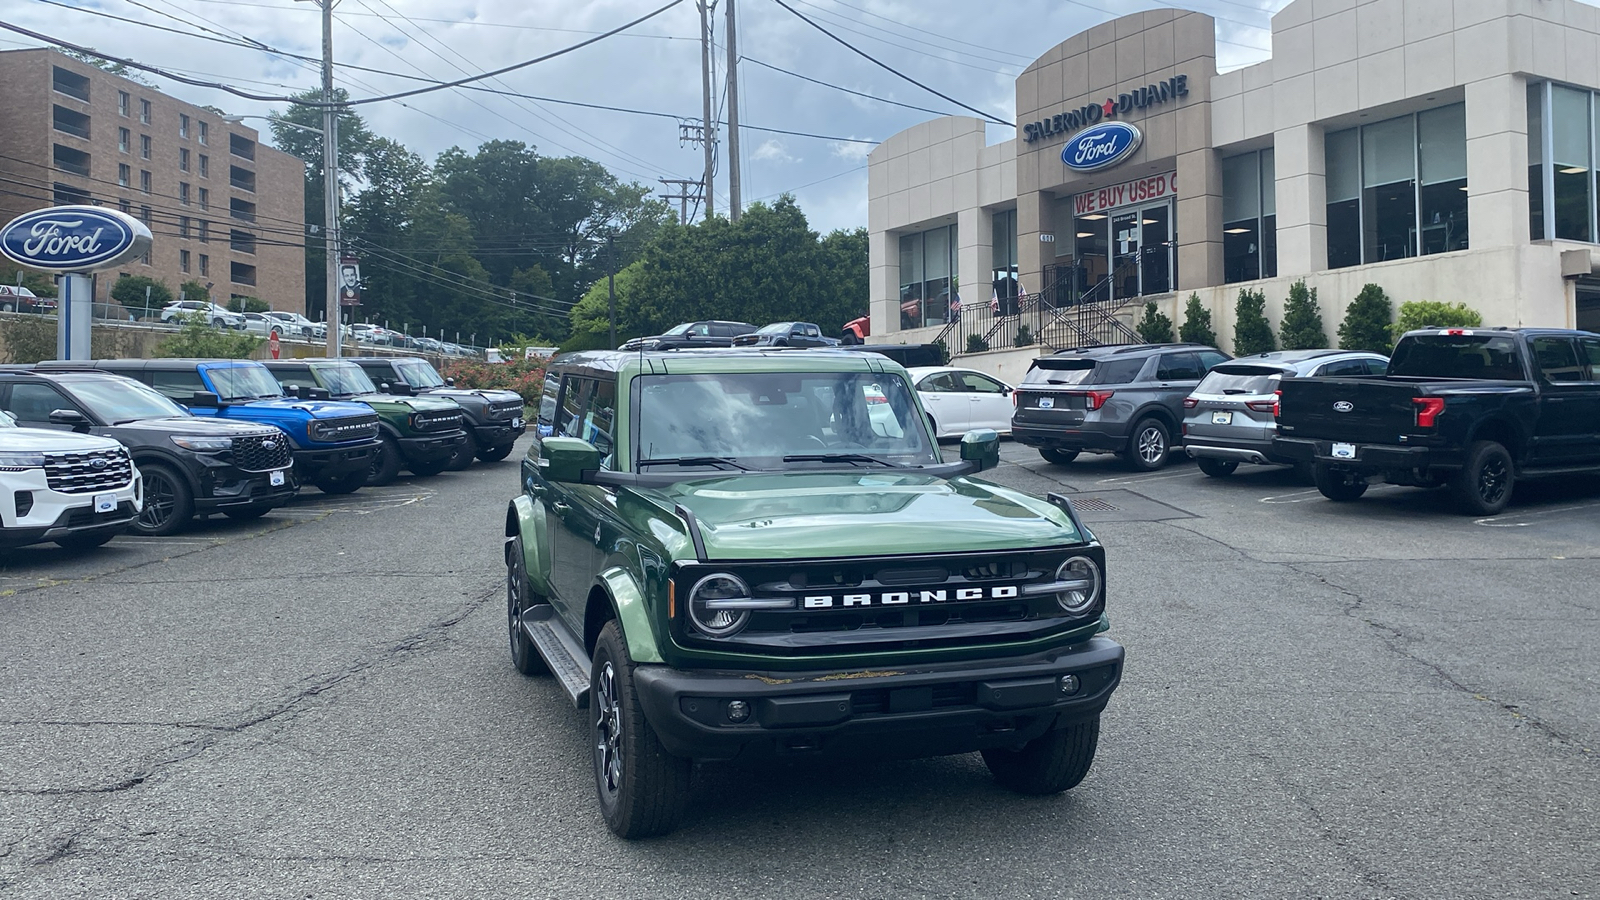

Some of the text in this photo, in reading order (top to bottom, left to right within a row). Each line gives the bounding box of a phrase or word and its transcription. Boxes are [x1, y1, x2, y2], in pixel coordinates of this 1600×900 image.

[1023, 75, 1189, 143] SALERNO DUANE
[1075, 133, 1117, 164] Ford
[1075, 192, 1095, 214] WE
[1099, 185, 1125, 209] BUY
[1129, 176, 1166, 202] USED
[23, 220, 104, 257] Ford
[804, 585, 1018, 609] BRONCO
